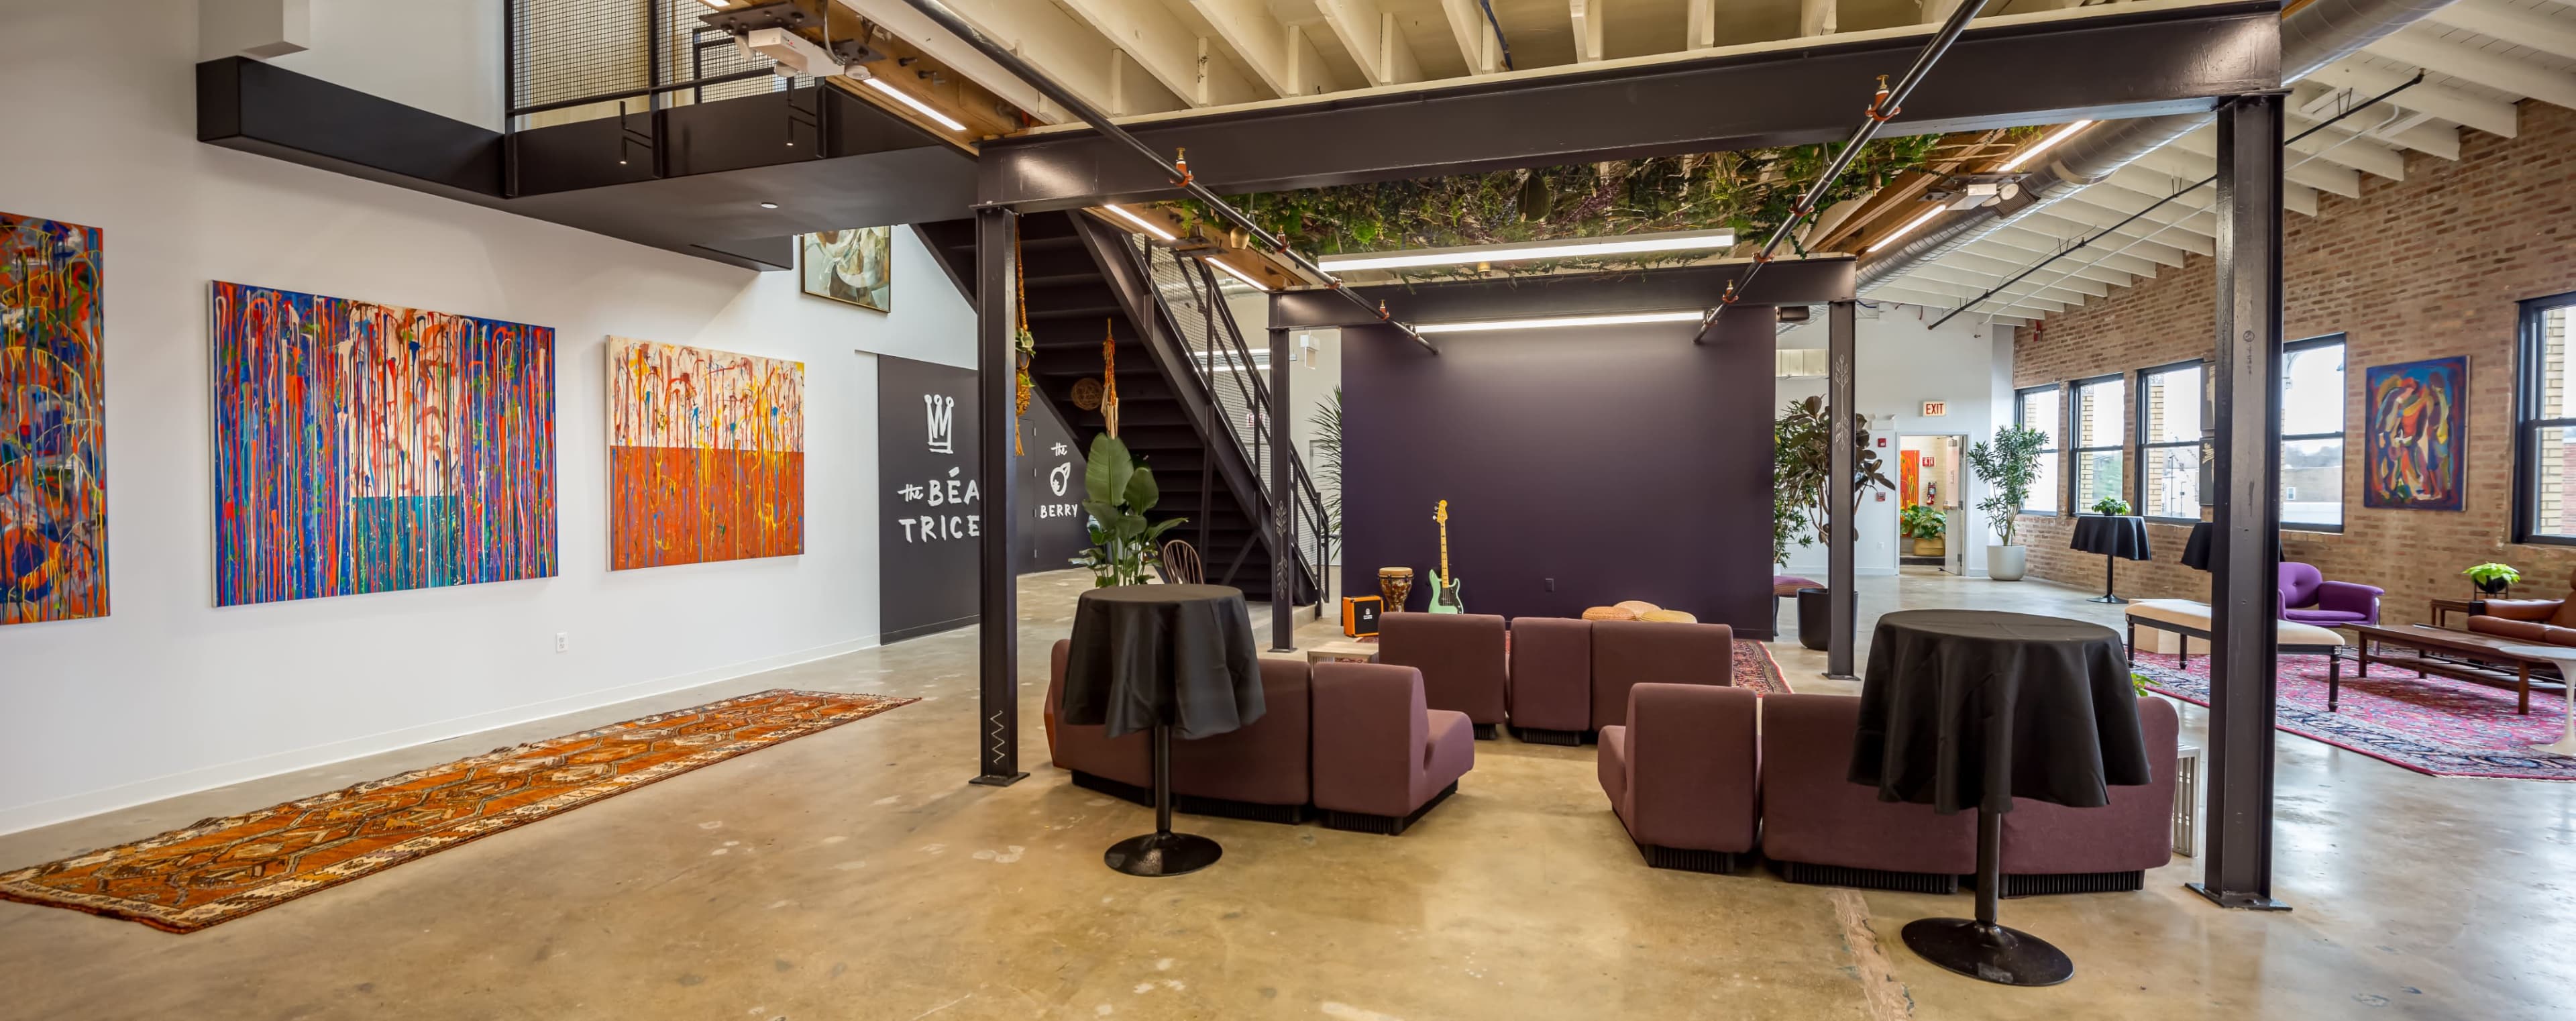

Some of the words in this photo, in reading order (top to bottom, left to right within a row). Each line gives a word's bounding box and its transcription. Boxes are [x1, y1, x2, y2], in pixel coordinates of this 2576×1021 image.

[1926, 403, 1943, 415] EXIT
[1051, 442, 1067, 456] the
[897, 484, 924, 502] the
[927, 466, 979, 506] BÉA
[1040, 504, 1078, 519] BERRY
[898, 515, 979, 543] TRICE
